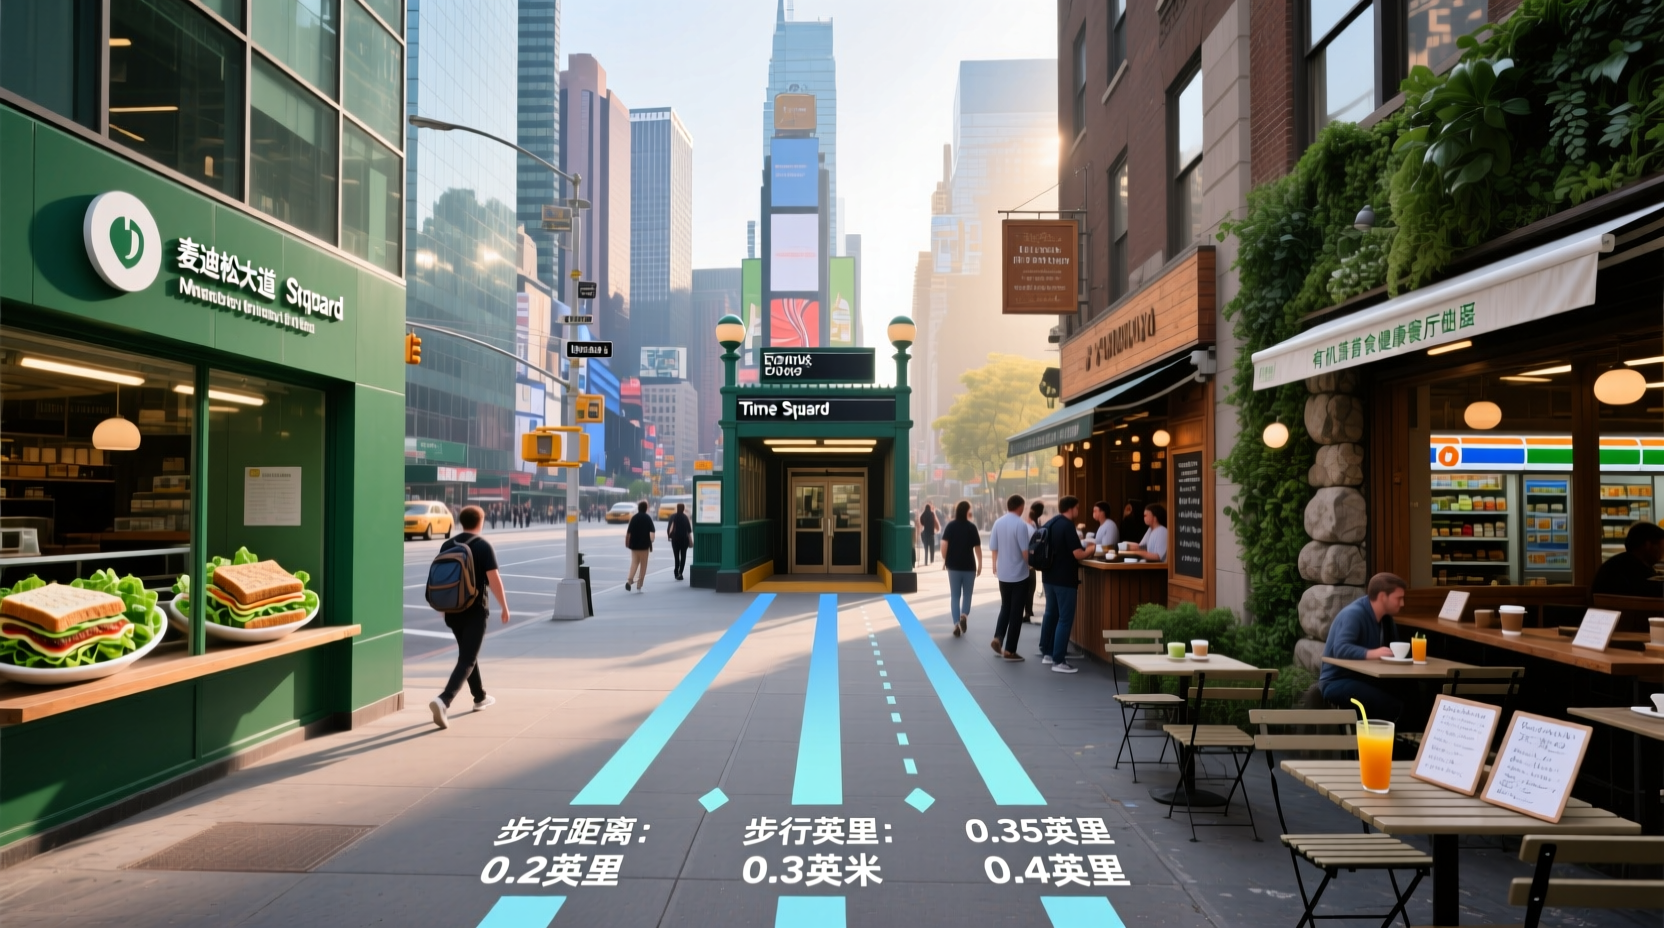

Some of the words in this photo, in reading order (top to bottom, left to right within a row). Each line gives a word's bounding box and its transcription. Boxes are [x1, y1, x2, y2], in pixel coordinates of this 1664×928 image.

[177, 237, 276, 300] 麦迪松大道
[739, 401, 778, 416] Time
[965, 816, 1116, 846] 0.35英里
[480, 853, 625, 887] 0.2英里
[742, 853, 884, 887] 0.3英米
[983, 853, 1132, 887] 0.4英里
